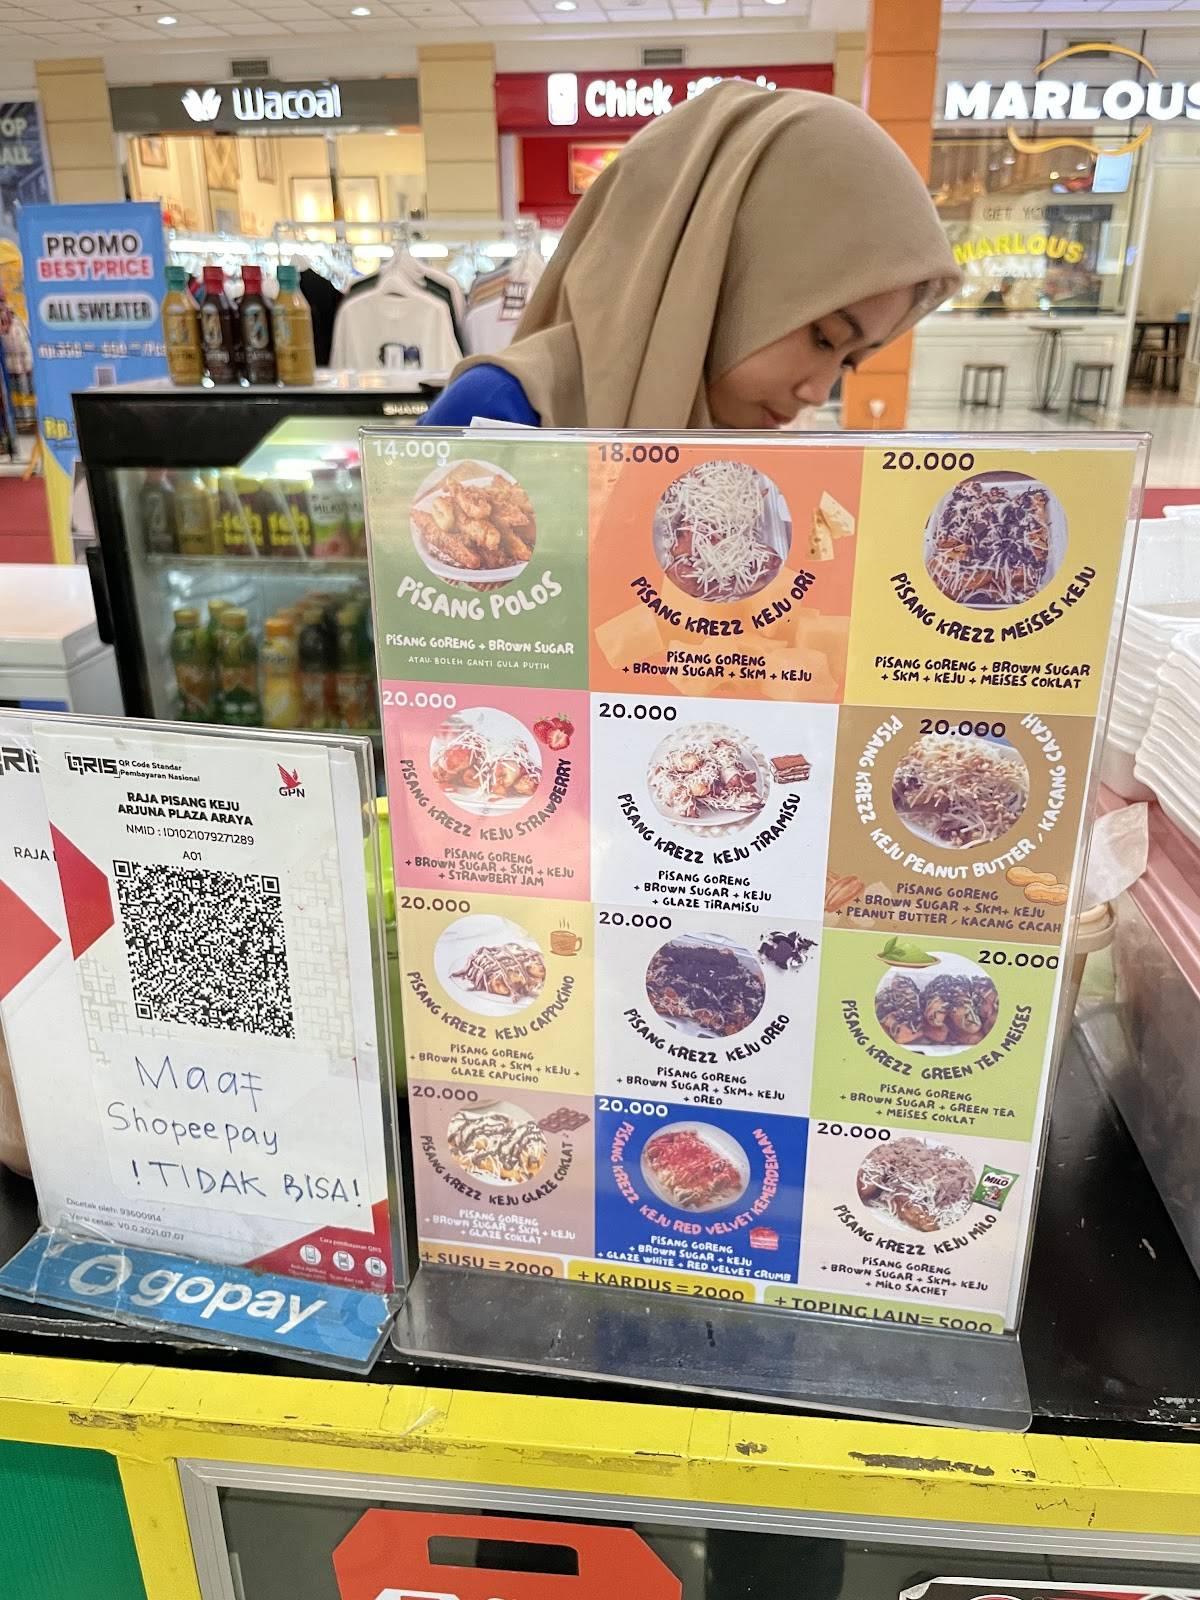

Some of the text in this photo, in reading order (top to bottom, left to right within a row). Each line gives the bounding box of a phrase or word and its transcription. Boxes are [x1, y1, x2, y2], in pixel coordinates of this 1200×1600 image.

[232, 84, 341, 120] Wacoal
[585, 78, 673, 118] Chick
[46, 234, 138, 256] PROMO
[953, 232, 1085, 264] MARLOUS
[39, 259, 151, 279] BEST PRICE
[48, 301, 151, 322] ALL SWEATER
[372, 440, 451, 460] 14.000
[598, 443, 680, 464] 18.000
[882, 452, 975, 471] 20.000
[489, 570, 562, 620] POLOS
[936, 619, 995, 643] KREZZ
[1061, 566, 1097, 608] KEJU
[685, 617, 744, 636] KREZZ
[752, 598, 792, 630] KEJU
[534, 641, 574, 655] SUGAR
[434, 657, 463, 666] BOLEH
[467, 658, 493, 667] GANTI
[497, 660, 519, 668] GULA
[523, 662, 550, 670] PUTIH
[682, 665, 724, 678] SUGAR
[740, 668, 766, 680] SKM
[781, 669, 812, 682] KEJU
[1045, 663, 1091, 677] SUGAR
[892, 670, 919, 682] SKM
[934, 672, 965, 684] KEJU
[1031, 677, 1082, 689] COKLAT
[382, 691, 457, 709] 20.000
[599, 702, 677, 721] 20.000
[919, 718, 1007, 738] 20.000
[1020, 712, 1062, 762] CACAH
[67, 755, 118, 775] QRIS
[118, 759, 182, 772] QR Code Standar
[120, 770, 200, 782] Pembayaran Nasional
[127, 792, 240, 812] RAJA PISANG KEJU
[278, 787, 306, 798] GPN
[428, 805, 472, 837] KREZZ
[480, 828, 514, 841] KEJU
[518, 758, 572, 836] STRAWBERRY
[855, 771, 877, 824] KREZZ
[1038, 765, 1067, 832] KACANG
[118, 804, 253, 827] ARJUNA PLAZA ARAYA
[126, 824, 254, 846] NMID ID1021079271289
[870, 827, 904, 861] KEJU
[13, 847, 49, 861] RAJA
[183, 851, 202, 861] A01
[654, 837, 704, 864] KREZZ
[713, 846, 750, 865] KEJU
[972, 838, 1037, 878] BUTTER
[903, 853, 969, 880] PEANUT
[663, 897, 700, 908] GLAZE
[690, 886, 729, 898] SUGAR
[743, 890, 772, 901] KEJU
[401, 896, 471, 913] 20.000
[599, 911, 672, 930] 20.000
[978, 950, 1059, 969] 20.000
[441, 1012, 487, 1038] KREZZ
[495, 1025, 528, 1040] KEJU
[668, 1044, 718, 1064] KREZZ
[725, 1040, 761, 1062] KEJU
[760, 1014, 790, 1046] OREO
[866, 1044, 913, 1076] KREZZ
[921, 1065, 973, 1080] GREEN
[974, 1051, 1004, 1071] TEA
[412, 1085, 479, 1102] 20.000
[598, 1098, 669, 1117] 20.000
[817, 1122, 891, 1141] 20.000
[443, 1173, 482, 1201] KREZZ
[489, 1194, 519, 1206] KEJU
[522, 1180, 558, 1204] GLAZE
[554, 1141, 573, 1181] COKLAT
[984, 1175, 1009, 1187] MILO
[283, 1172, 362, 1208] BISA!
[673, 1220, 701, 1236] RED
[705, 1212, 755, 1236] VELVET
[875, 1237, 926, 1256] KREZZ
[933, 1235, 969, 1255] KEJU
[438, 1253, 554, 1278] SUSU 2000
[607, 1251, 640, 1262] GLAZE
[687, 1261, 708, 1271] RED
[712, 1266, 751, 1277] VELVET
[754, 1270, 791, 1282] CRUMB
[595, 1272, 744, 1301] KARDUS 2000
[130, 1268, 328, 1334] gopay
[791, 1297, 867, 1318] TOPING
[938, 1317, 993, 1333] 5000
